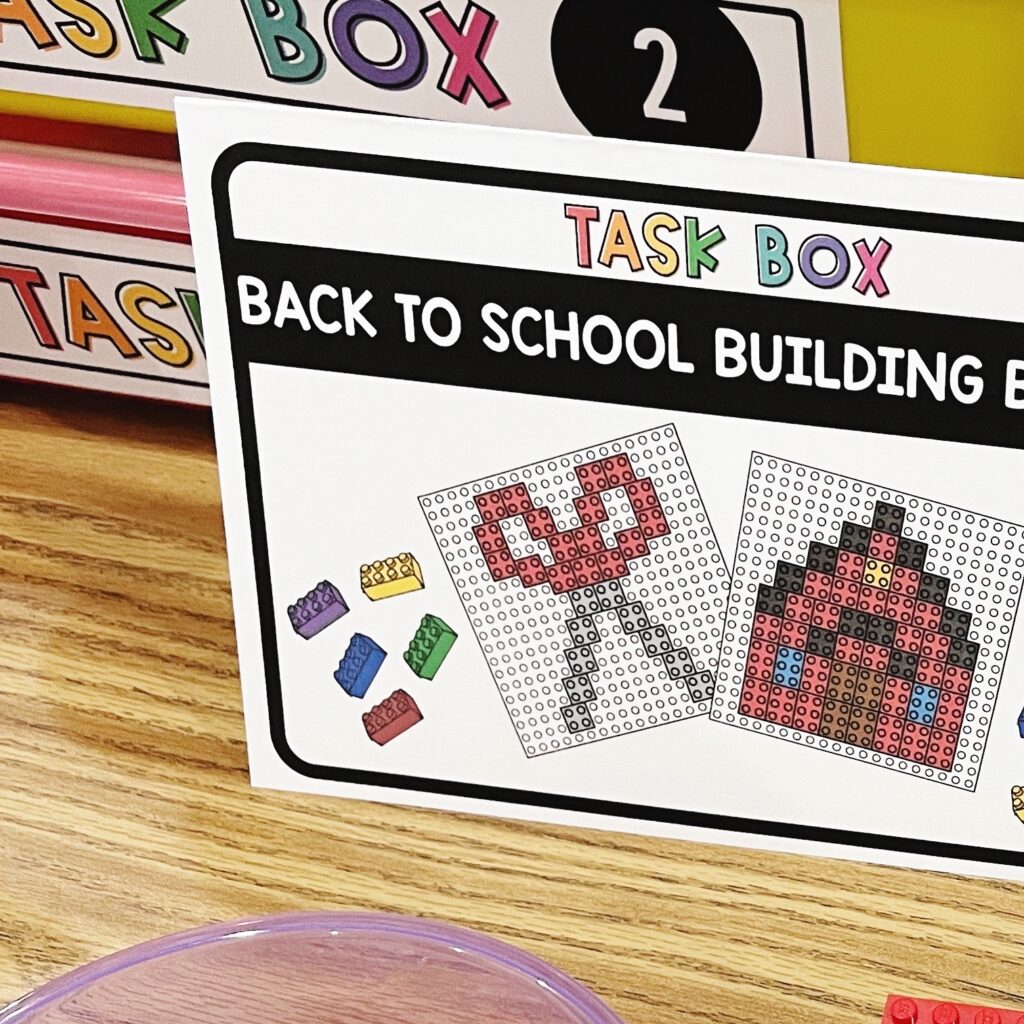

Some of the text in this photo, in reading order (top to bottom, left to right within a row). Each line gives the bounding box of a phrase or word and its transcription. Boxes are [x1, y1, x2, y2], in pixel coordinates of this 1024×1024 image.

[239, 0, 511, 110] BOX
[633, 27, 687, 123] 2
[564, 203, 892, 297] TASK BOX
[237, 275, 378, 338] BACK
[394, 292, 462, 347] TO
[481, 302, 694, 374] SCHOOL
[714, 328, 984, 404] BUILDING
